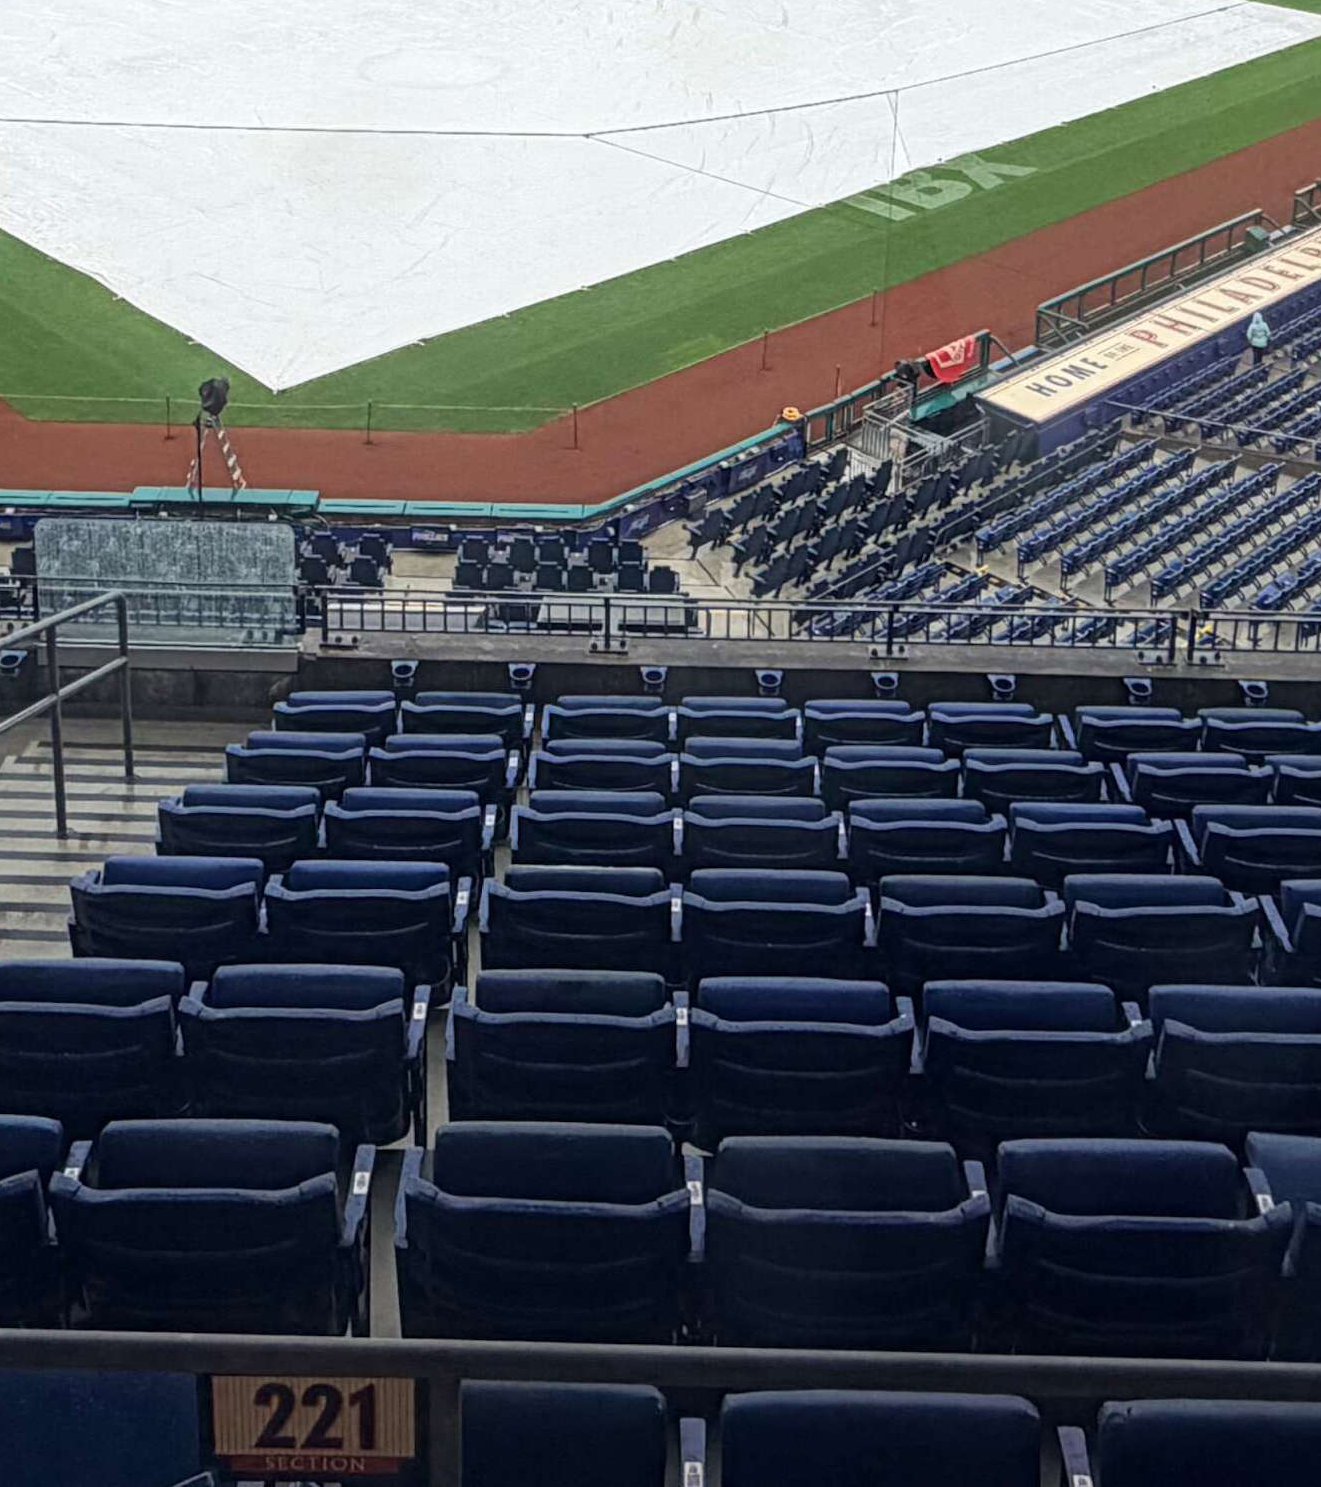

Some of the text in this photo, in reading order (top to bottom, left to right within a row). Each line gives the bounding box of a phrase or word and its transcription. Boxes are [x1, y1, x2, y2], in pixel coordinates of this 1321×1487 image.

[1026, 355, 1109, 398] HOME
[253, 1382, 376, 1450] 221
[265, 1456, 366, 1472] SECTION
